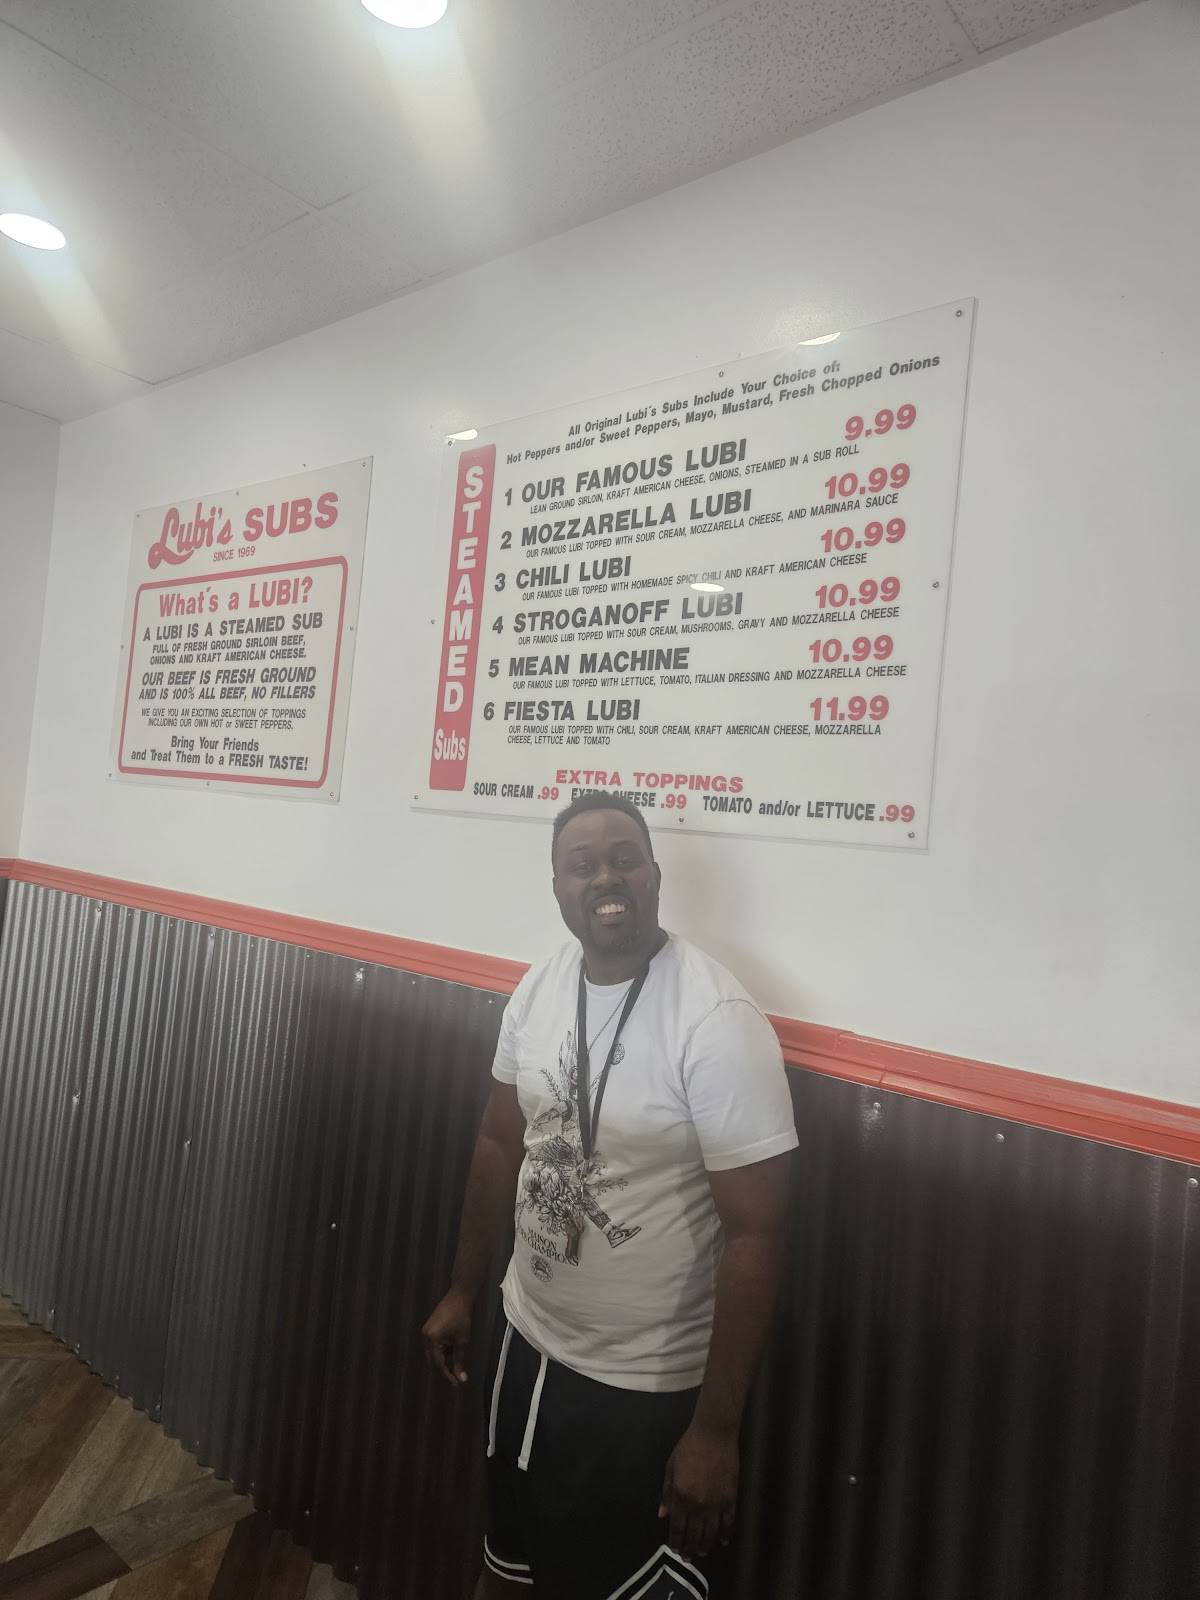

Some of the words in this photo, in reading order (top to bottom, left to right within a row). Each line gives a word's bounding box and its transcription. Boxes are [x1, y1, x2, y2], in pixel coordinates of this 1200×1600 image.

[506, 452, 521, 464] Hot
[524, 445, 560, 460] Peppers
[564, 437, 595, 451] and/or
[599, 426, 630, 443] Sweet
[634, 418, 680, 435] Peppers,
[685, 409, 716, 424] Mayo,
[722, 393, 773, 415] Mustard,
[778, 383, 814, 402] Fresh
[821, 366, 882, 392] Chopped
[889, 356, 940, 376] Onions
[568, 424, 580, 436] All
[584, 413, 622, 432] Original
[626, 407, 656, 422] Lubi's
[661, 399, 688, 414] Subs
[693, 387, 734, 406] Include
[741, 380, 766, 394] Your
[773, 368, 816, 386] Choice
[844, 404, 916, 441] 9.99
[504, 488, 512, 506] 1
[521, 476, 565, 503] OUR
[575, 454, 672, 493] FAMOUS
[685, 438, 746, 472] LUBI
[744, 458, 786, 475] STEAMED
[789, 455, 798, 466] IN
[802, 454, 808, 464] A
[813, 449, 831, 462] SUB
[835, 444, 859, 457] ROLL
[824, 463, 910, 499] 10.99
[148, 502, 234, 569] Lubi's
[243, 492, 338, 541] SUBS
[500, 530, 512, 550] 2
[521, 502, 676, 546] MOZZARELLA
[690, 488, 751, 520] LUBI
[635, 531, 655, 543] SOUR
[690, 518, 744, 534] MOZZARELLA
[787, 508, 806, 520] AND
[810, 499, 860, 516] MARINARA
[865, 492, 899, 508] SAUCE
[820, 517, 906, 553] 10.99
[213, 549, 234, 562] SINCE
[238, 545, 255, 558] 1969
[494, 572, 506, 592] 3
[516, 563, 569, 589] CHILI
[579, 555, 631, 582] LUBI
[630, 576, 673, 589] HOMEMADE
[724, 568, 742, 579] AND
[746, 564, 775, 576] KRAFT
[778, 558, 826, 573] AMERICAN
[829, 552, 867, 567] CHEESE
[159, 587, 218, 617] What's
[228, 592, 239, 610] a
[248, 576, 313, 608] LUBI?
[443, 466, 484, 712] STEAMED
[815, 576, 900, 609] 10.99
[142, 627, 150, 641] A
[156, 624, 182, 640] LUBI
[187, 622, 198, 638] IS
[204, 622, 212, 636] A
[219, 615, 285, 636] STEAMED
[291, 612, 322, 630] SUB
[492, 616, 503, 634] 4
[513, 599, 669, 633] STROGANOFF
[681, 592, 742, 619] LUBI
[626, 627, 646, 637] SOUR
[738, 617, 765, 630] GRAVY
[769, 616, 788, 627] AND
[791, 610, 855, 625] MOZZARELLA
[860, 606, 900, 620] CHEESE
[150, 654, 175, 665] ONIONS
[178, 654, 193, 664] AND
[196, 652, 222, 663] KRAFT
[224, 649, 266, 661] AMERICAN
[152, 644, 168, 653] FULL
[171, 642, 181, 652] OF
[183, 641, 208, 652] FRESH
[210, 638, 242, 650] GROUND
[245, 636, 278, 648] SIRLOIN
[808, 634, 893, 663] 10.99
[142, 672, 164, 686] OUR
[167, 670, 196, 685] BEEF
[199, 670, 211, 684] IS
[214, 668, 256, 684] FRESH
[260, 666, 316, 683] GROUND
[488, 659, 499, 678] 5
[508, 654, 569, 676] MEAN
[579, 647, 690, 673] MACHINE
[694, 673, 725, 683] ITALIAN
[728, 671, 770, 682] DRESSING
[774, 670, 792, 680] AND
[796, 667, 860, 680] MOZZARELLA
[866, 665, 907, 677] CHEESE
[138, 688, 156, 699] AND
[159, 688, 169, 700] IS
[172, 686, 194, 699] 100%
[198, 687, 215, 699] ALL
[219, 686, 246, 701] BEEF,
[251, 686, 266, 699] NO
[270, 685, 316, 699] FILLERS
[810, 695, 889, 721] 11.99
[191, 708, 218, 717] EXCITING
[220, 708, 256, 718] SELECTION
[258, 708, 268, 718] OF
[271, 708, 306, 718] TOPPINGS
[483, 701, 494, 720] 6
[503, 700, 574, 721] FIESTA
[586, 699, 640, 720] LUBI
[170, 735, 194, 751] Bring
[199, 736, 219, 750] Your
[223, 737, 259, 751] Friends
[434, 728, 466, 761] Subs
[534, 735, 564, 744] LETTUCE
[565, 735, 580, 744] AND
[583, 735, 610, 745] TOMATO
[638, 725, 659, 734] SOUR
[694, 725, 722, 734] KRAFT
[725, 724, 770, 735] AMERICAN
[814, 724, 881, 735] MOZZARELLA
[131, 748, 146, 760] and
[150, 749, 171, 762] Treat
[176, 750, 200, 764] Them
[205, 752, 214, 764] to
[218, 755, 224, 765] a
[228, 752, 264, 768] FRESH
[268, 755, 308, 770] TASTE!
[556, 770, 622, 786] EXTRA
[633, 772, 743, 793] TOPPINGS
[473, 782, 497, 796] SOUR
[501, 783, 534, 798] CREAM
[537, 786, 559, 800] .99
[660, 793, 686, 809] .99
[702, 795, 752, 814] TOMATO
[758, 800, 800, 816] and/or
[806, 801, 875, 821] LETTUCE
[879, 804, 914, 822] .99
